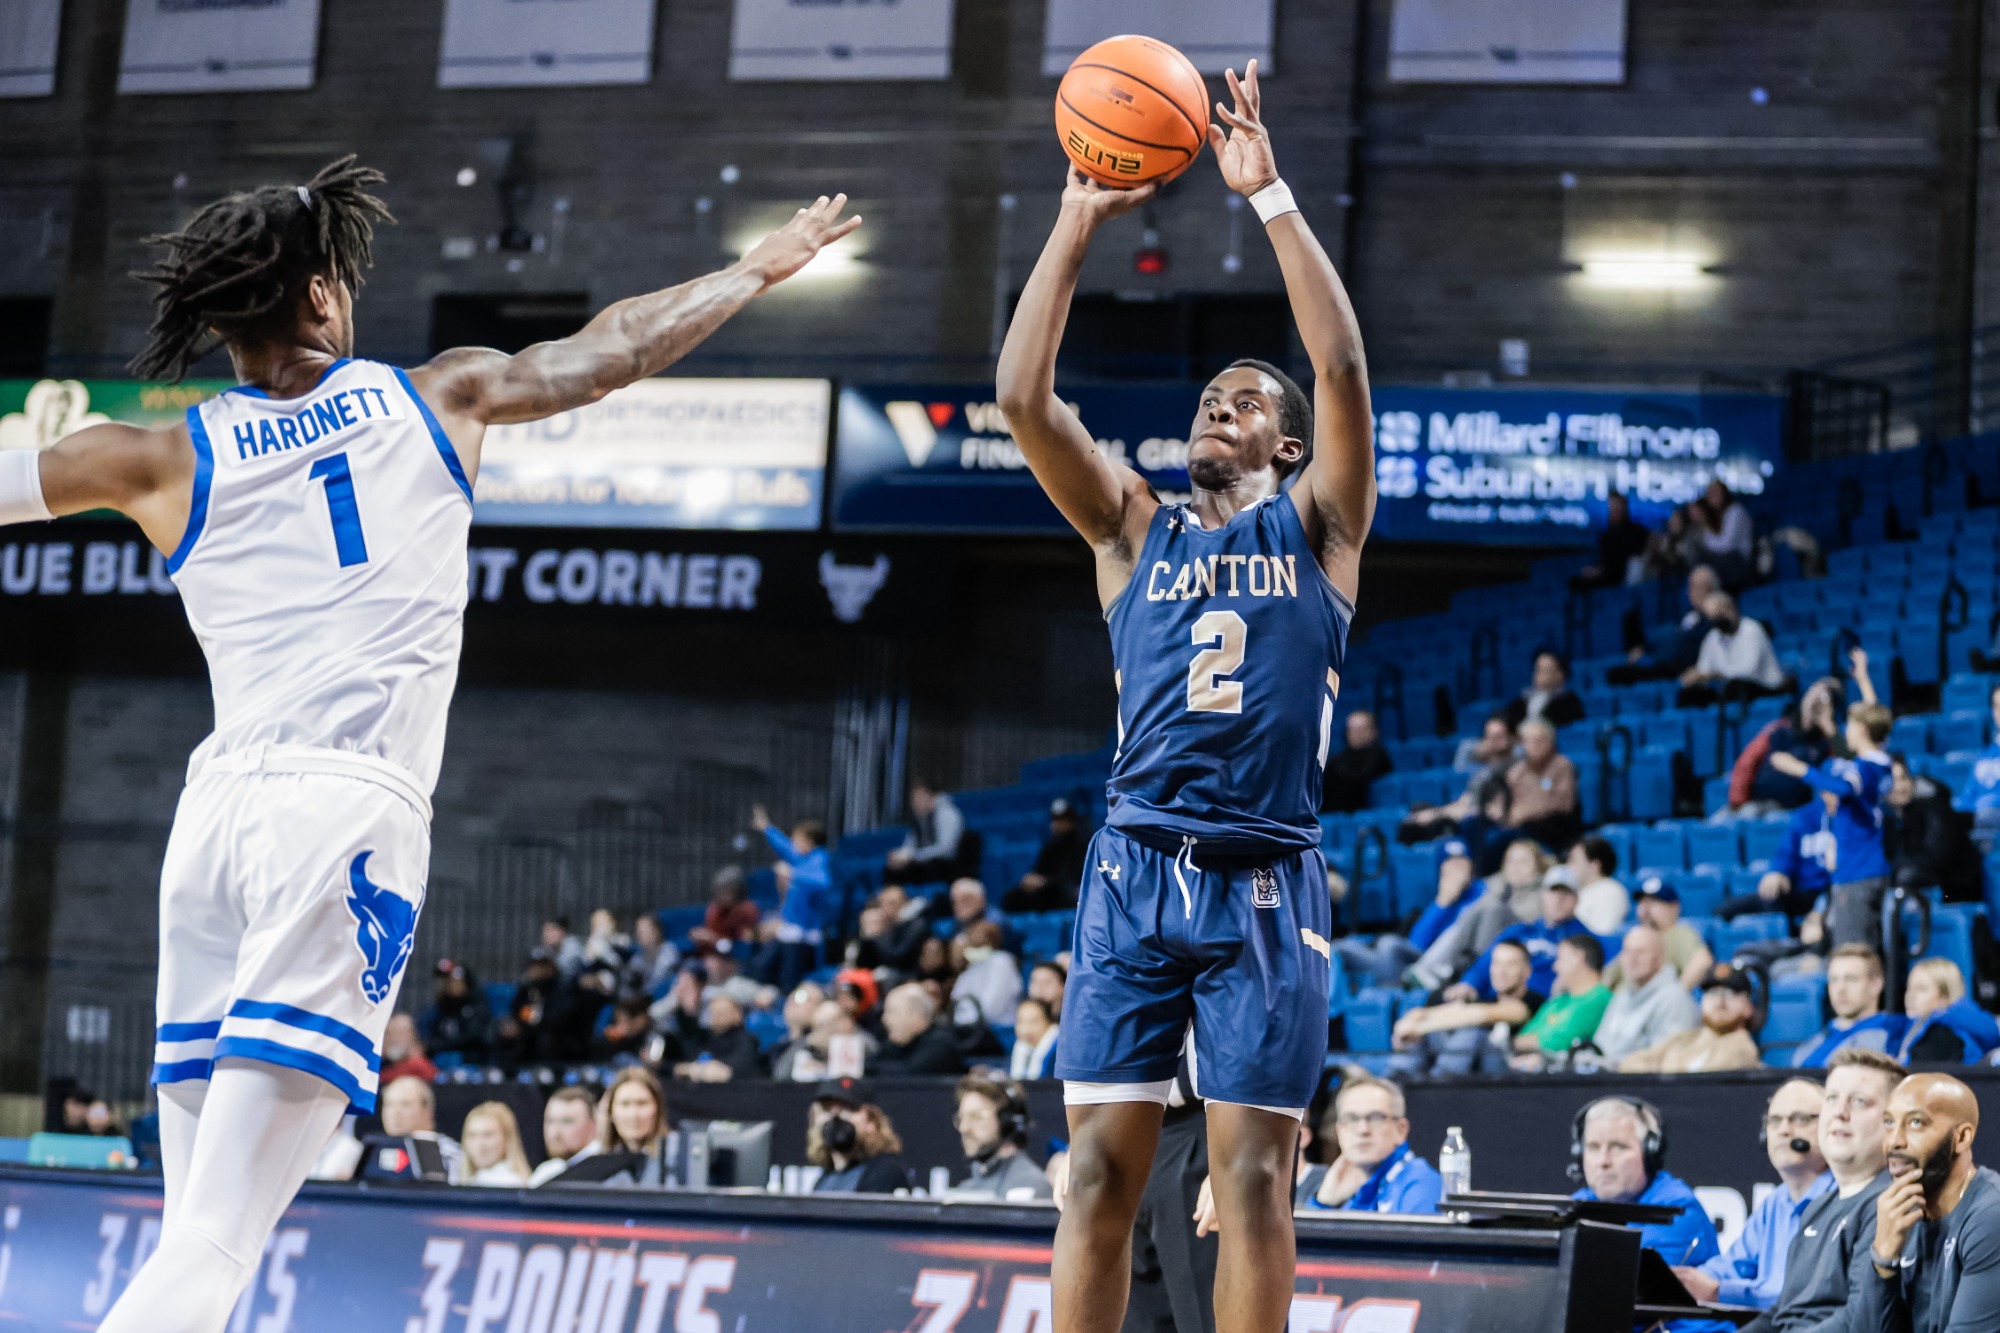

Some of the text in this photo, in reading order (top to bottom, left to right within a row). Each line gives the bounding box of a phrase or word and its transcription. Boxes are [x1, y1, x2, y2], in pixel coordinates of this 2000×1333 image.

[1068, 129, 1141, 175] ELITE
[233, 387, 390, 460] HARDNETT
[1428, 411, 1721, 461] Millard Fillmore
[1424, 454, 1609, 501] Suburban
[308, 452, 369, 568] 1
[81, 540, 180, 596] BLU
[522, 547, 763, 610] CORNER
[1146, 554, 1298, 601] CANTON
[1186, 610, 1248, 714] 2
